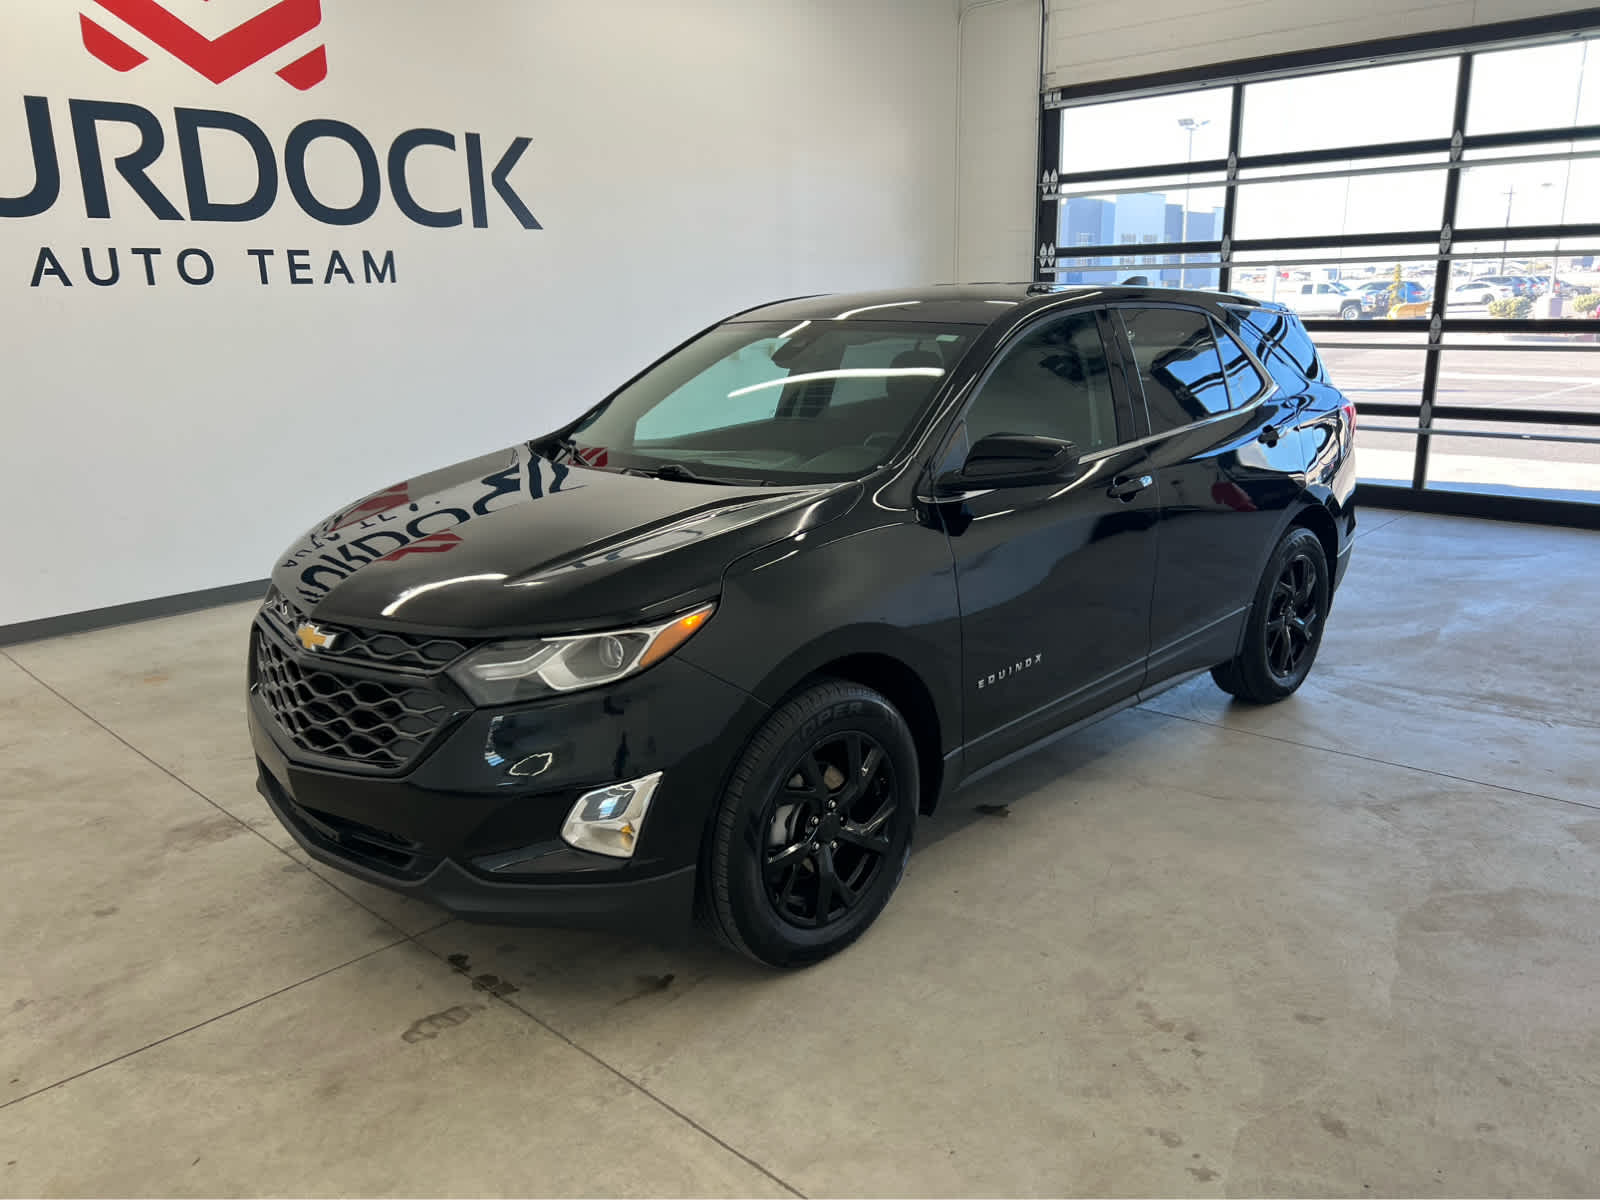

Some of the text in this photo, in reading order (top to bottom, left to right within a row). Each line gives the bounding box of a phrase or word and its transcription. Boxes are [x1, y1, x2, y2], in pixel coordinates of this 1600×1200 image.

[30, 246, 397, 287] AUTO TEAM
[977, 652, 1042, 689] EQUINOX
